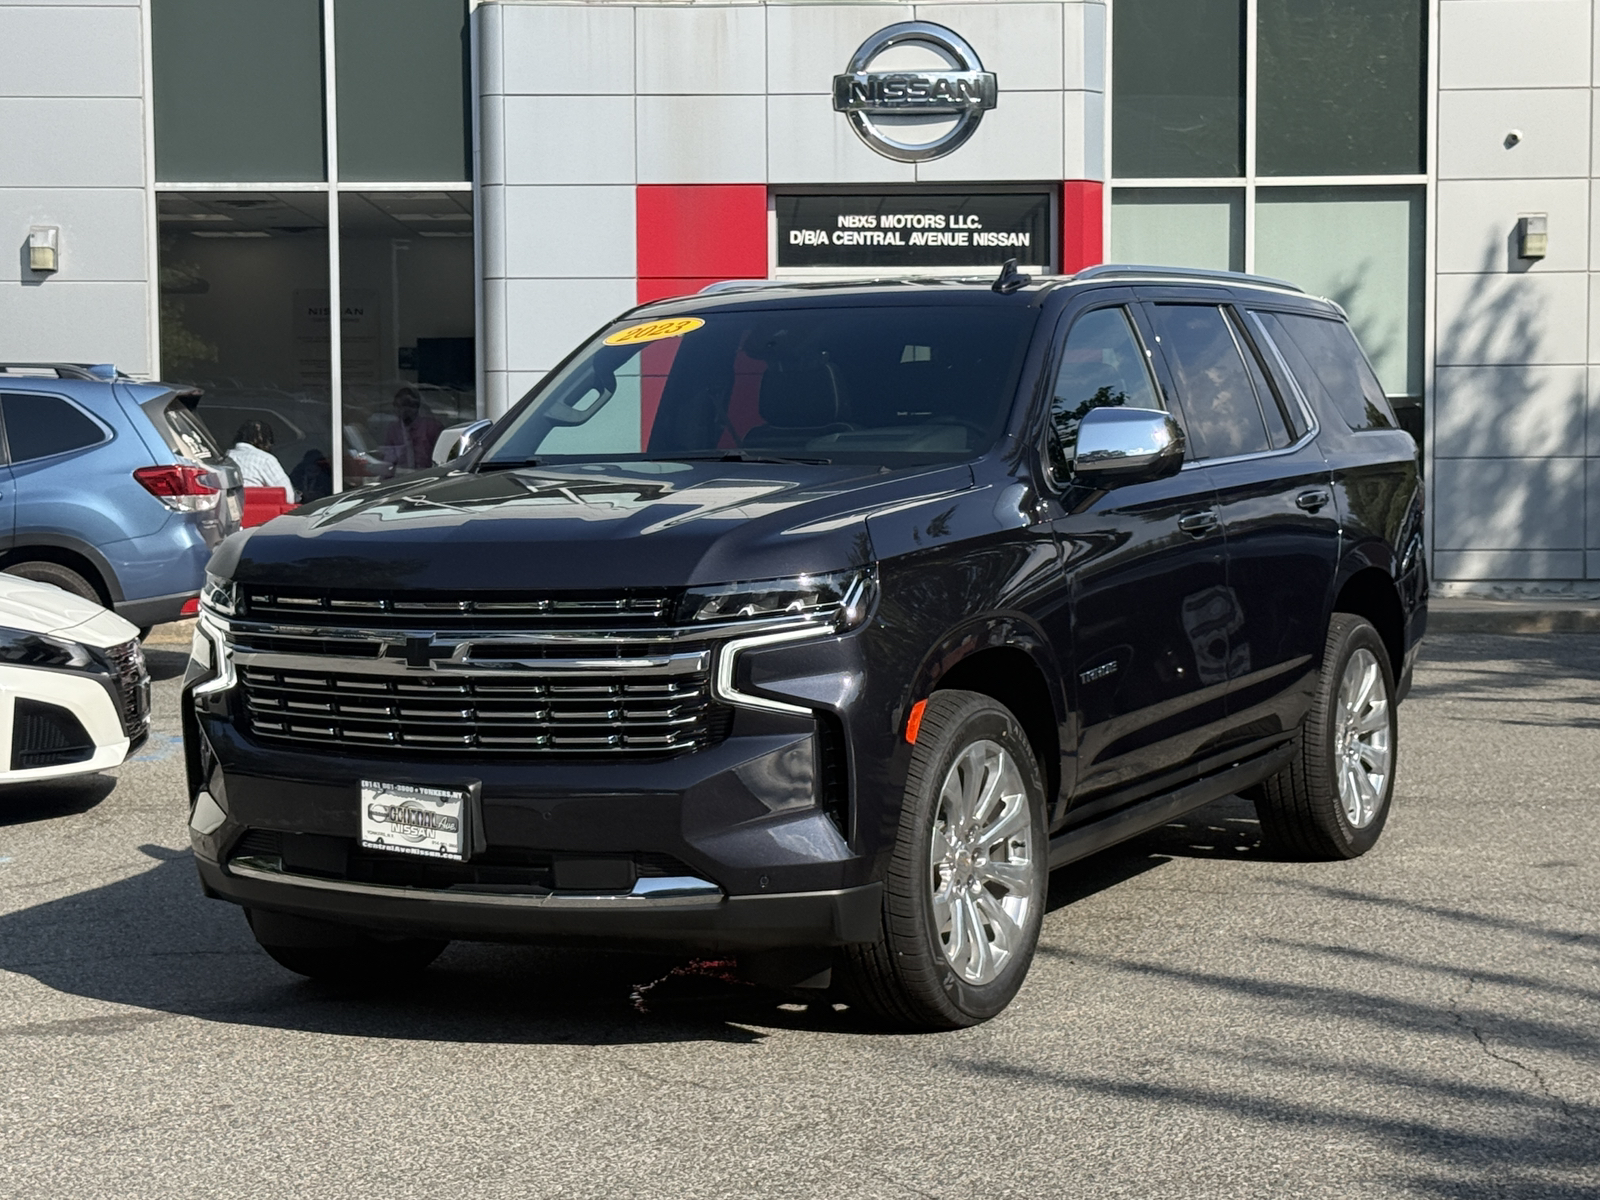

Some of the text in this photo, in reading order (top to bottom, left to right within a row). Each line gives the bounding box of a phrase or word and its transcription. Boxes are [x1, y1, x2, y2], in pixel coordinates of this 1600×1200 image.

[850, 78, 981, 103] NISSAN
[880, 215, 946, 229] MOTORS
[949, 215, 982, 229] LLC.
[789, 230, 1030, 247] D/B/A CENTRAL AVENUE NISSAN
[308, 307, 364, 316] NISAN
[616, 320, 691, 343] 2023
[1079, 660, 1118, 685] TAHOE
[390, 806, 437, 829] CENTRAL
[391, 822, 436, 839] NISSAN
